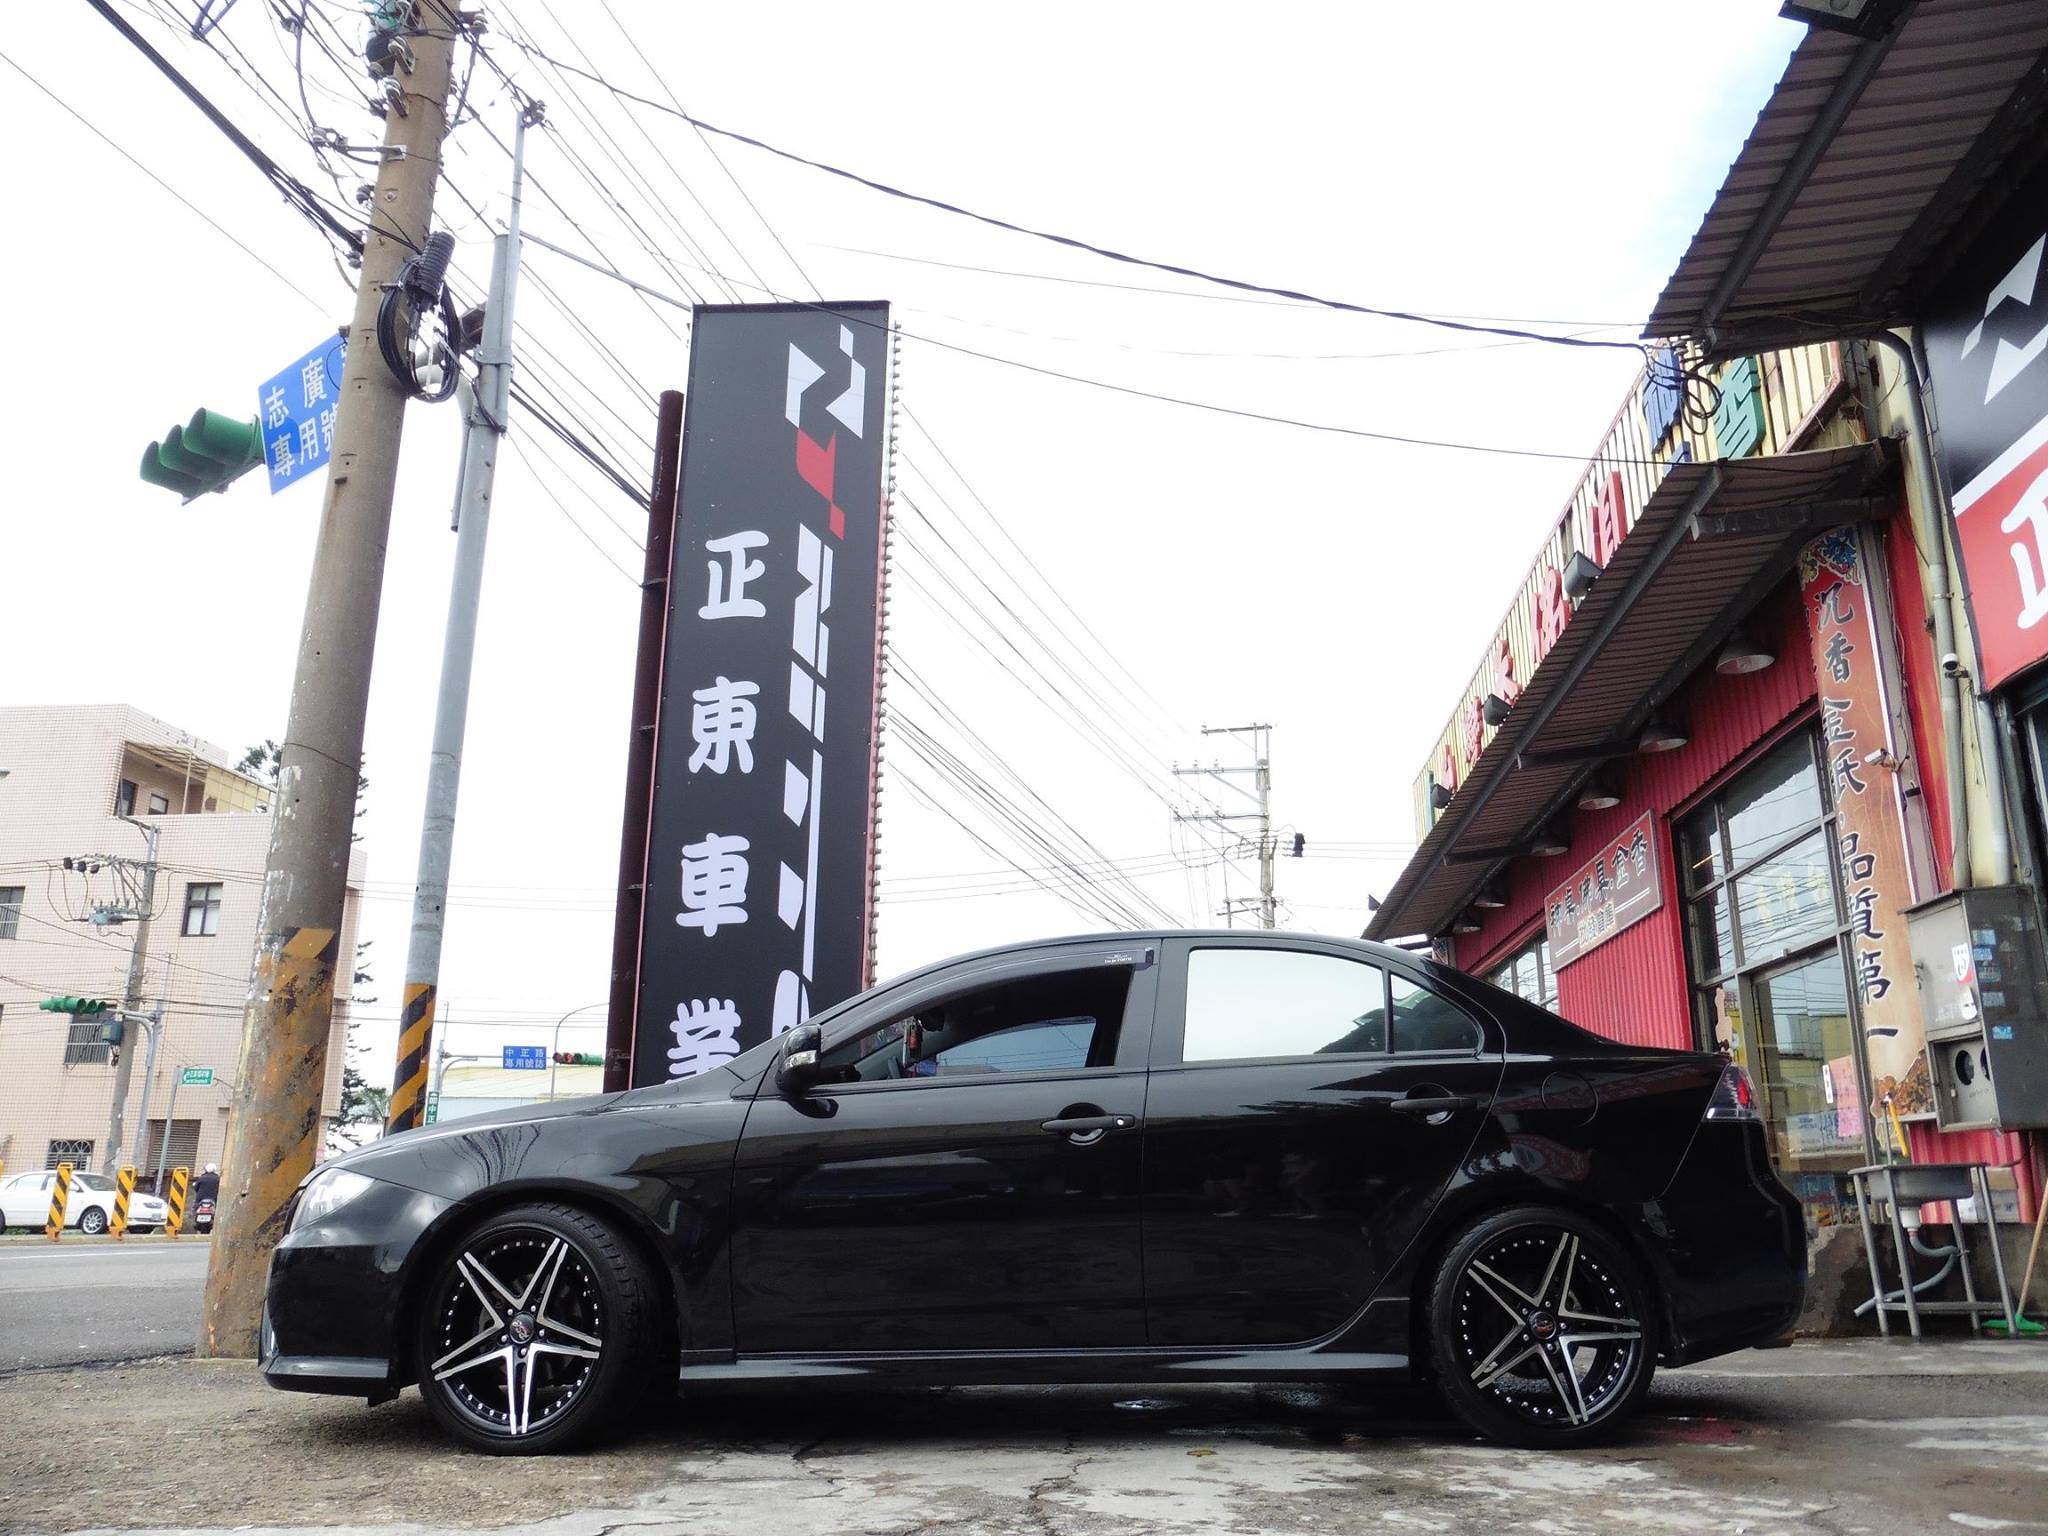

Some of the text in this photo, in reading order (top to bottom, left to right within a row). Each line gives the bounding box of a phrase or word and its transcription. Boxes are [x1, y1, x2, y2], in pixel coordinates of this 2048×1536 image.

[265, 343, 348, 431] 志廣
[664, 530, 771, 1085] 正東車業
